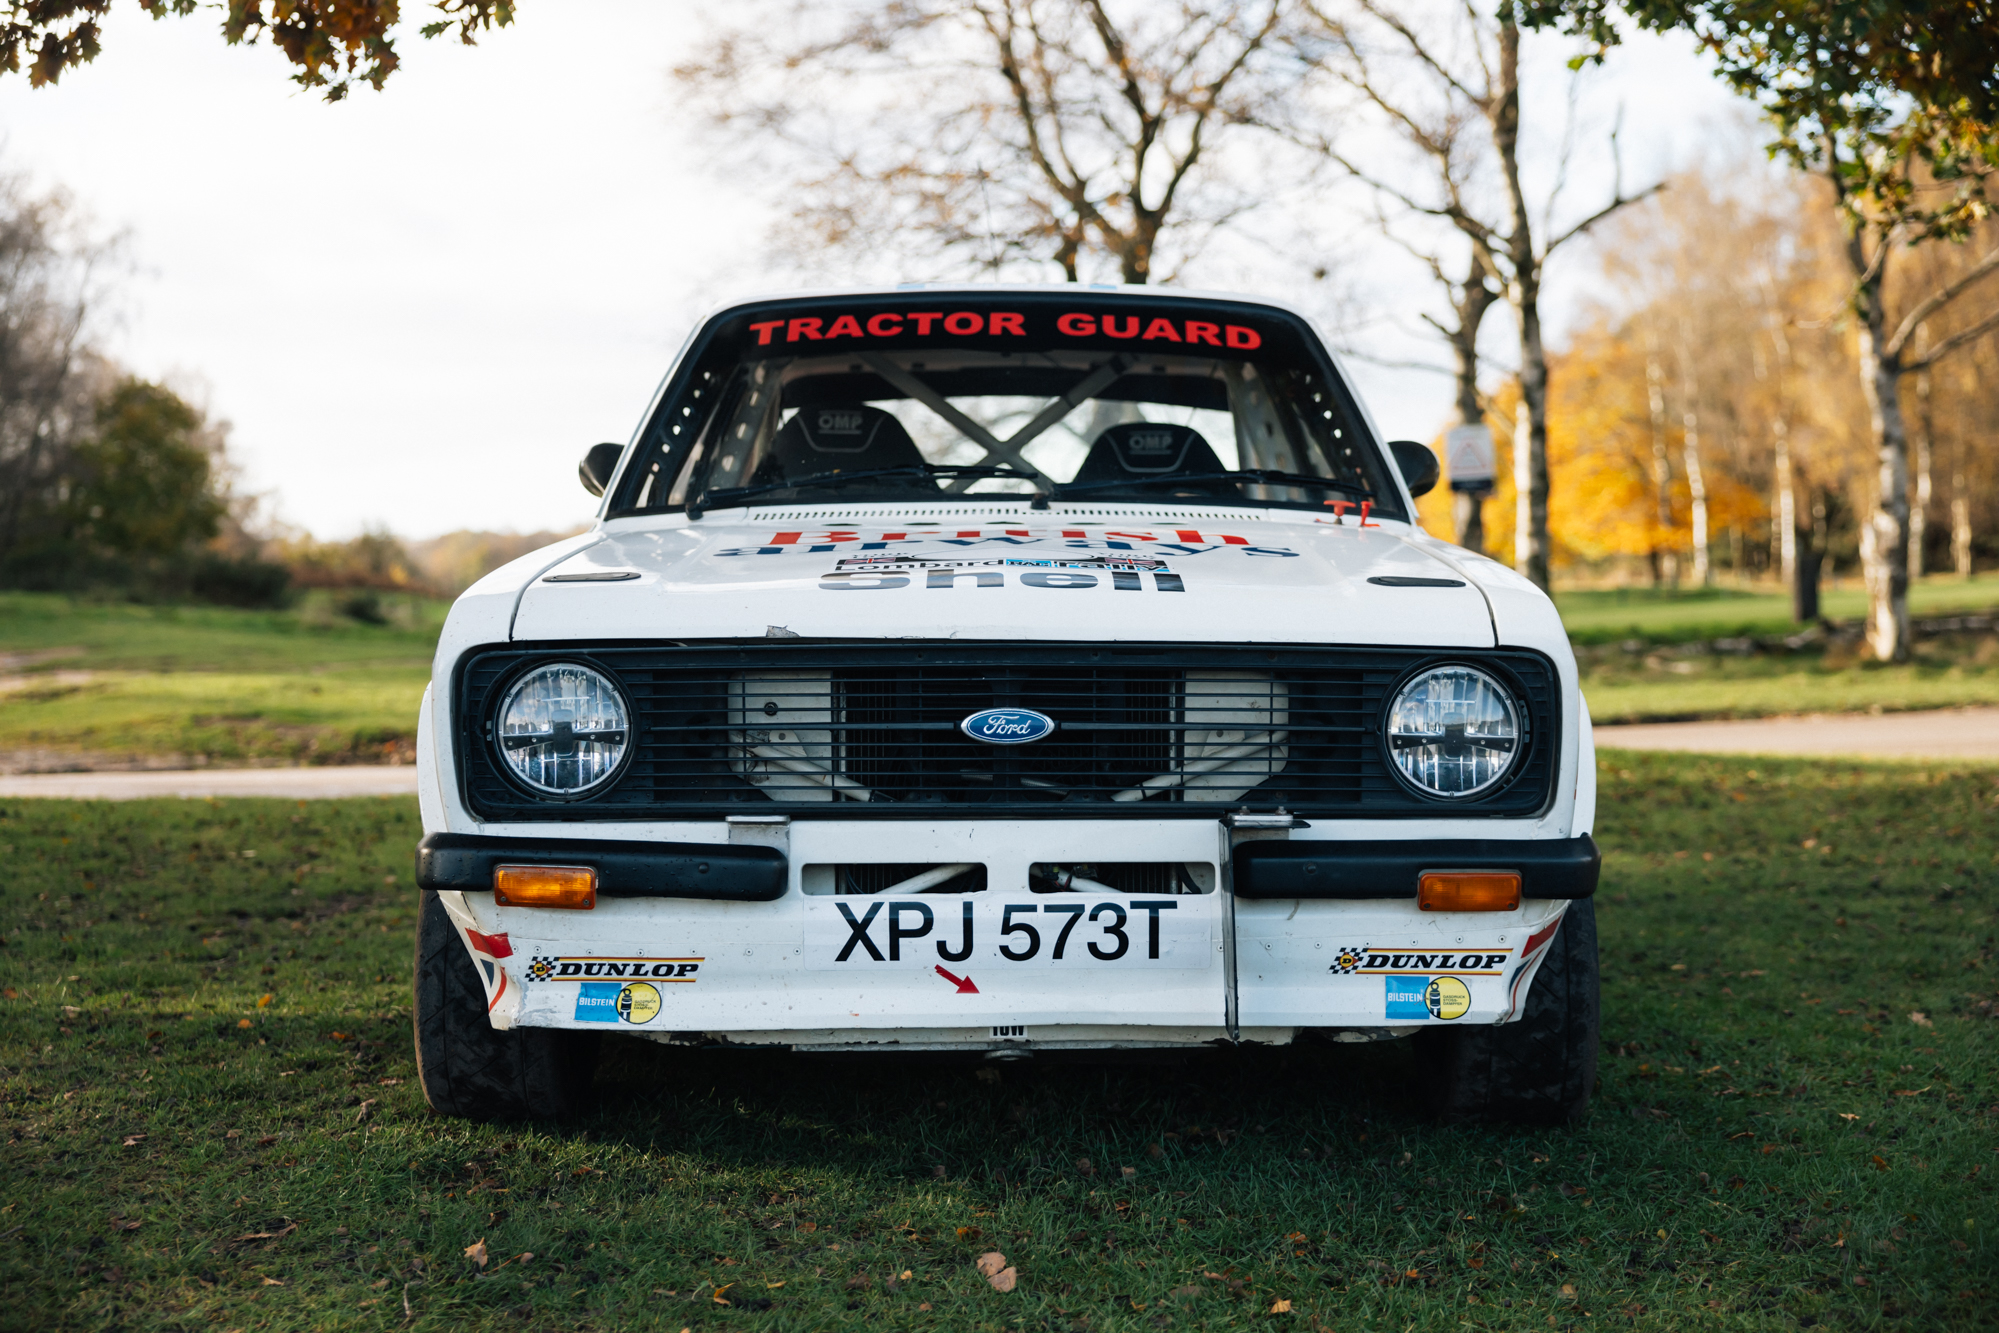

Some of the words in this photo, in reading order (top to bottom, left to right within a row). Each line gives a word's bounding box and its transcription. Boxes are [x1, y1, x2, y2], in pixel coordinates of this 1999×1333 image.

[749, 312, 1027, 346] TRACTOR
[1057, 312, 1262, 350] GUARD
[818, 415, 863, 430] OMP
[1129, 436, 1172, 449] OMP
[756, 529, 1254, 545] British
[713, 537, 1300, 557] airways
[834, 558, 1004, 571] Lombard
[818, 569, 1186, 593] Shell
[983, 715, 1032, 735] Ford
[834, 901, 974, 961] XPJ
[998, 900, 1178, 961] 573T
[1361, 954, 1508, 969] DUNLOP
[556, 963, 699, 977] DUNLOP
[578, 997, 616, 1006] BILSTEIN
[1388, 992, 1423, 1002] BILSTEIN
